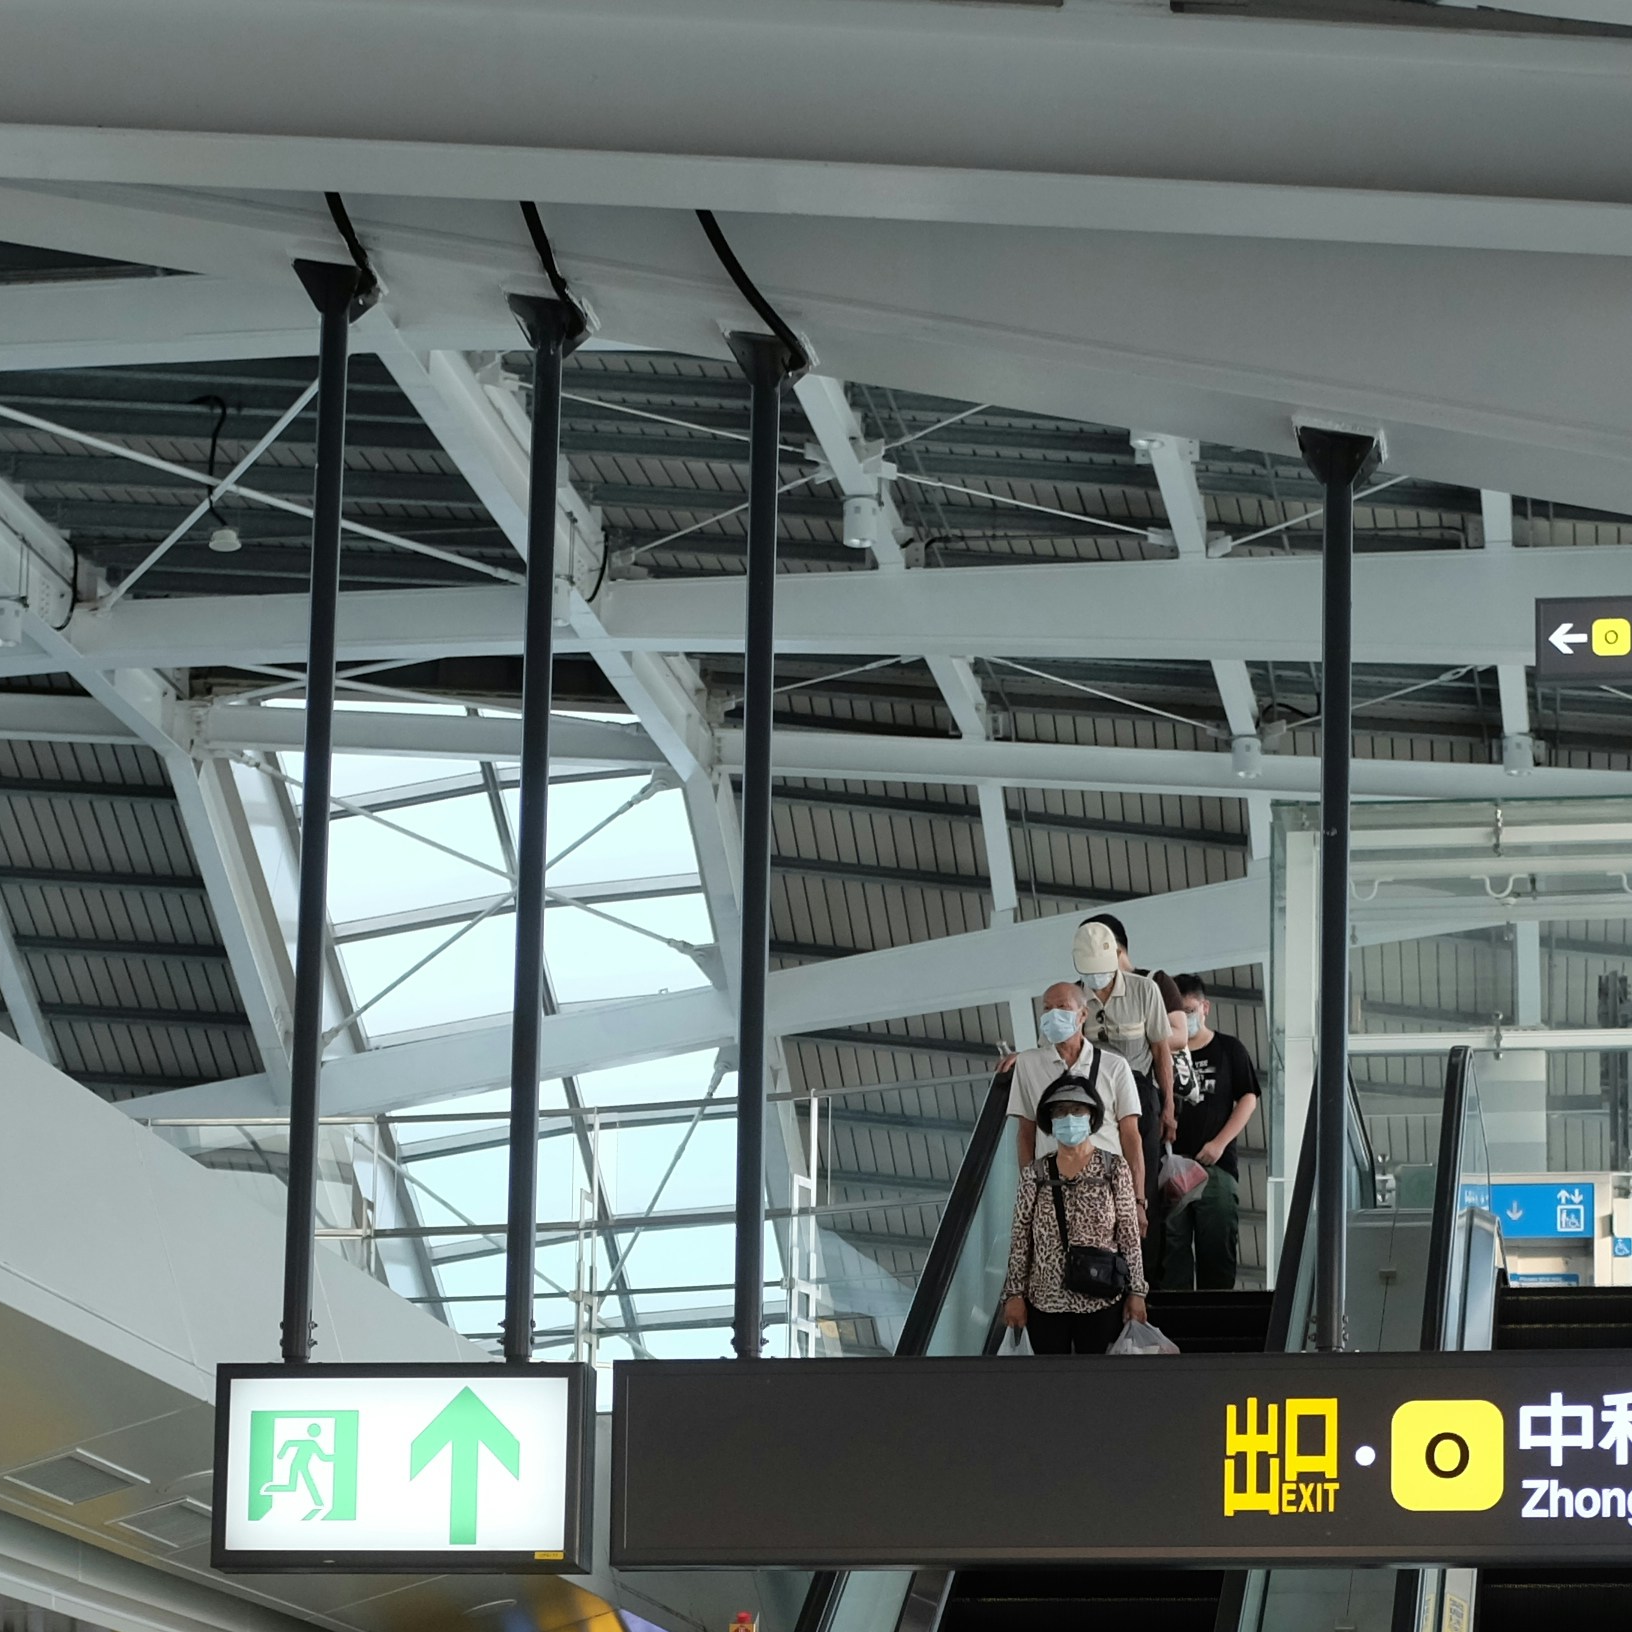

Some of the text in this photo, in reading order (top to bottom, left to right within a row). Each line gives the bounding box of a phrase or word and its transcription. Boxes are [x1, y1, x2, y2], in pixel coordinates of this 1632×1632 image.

[1224, 1397, 1338, 1516] 出口
[1424, 1432, 1469, 1479] O
[1282, 1482, 1339, 1513] EXIT
